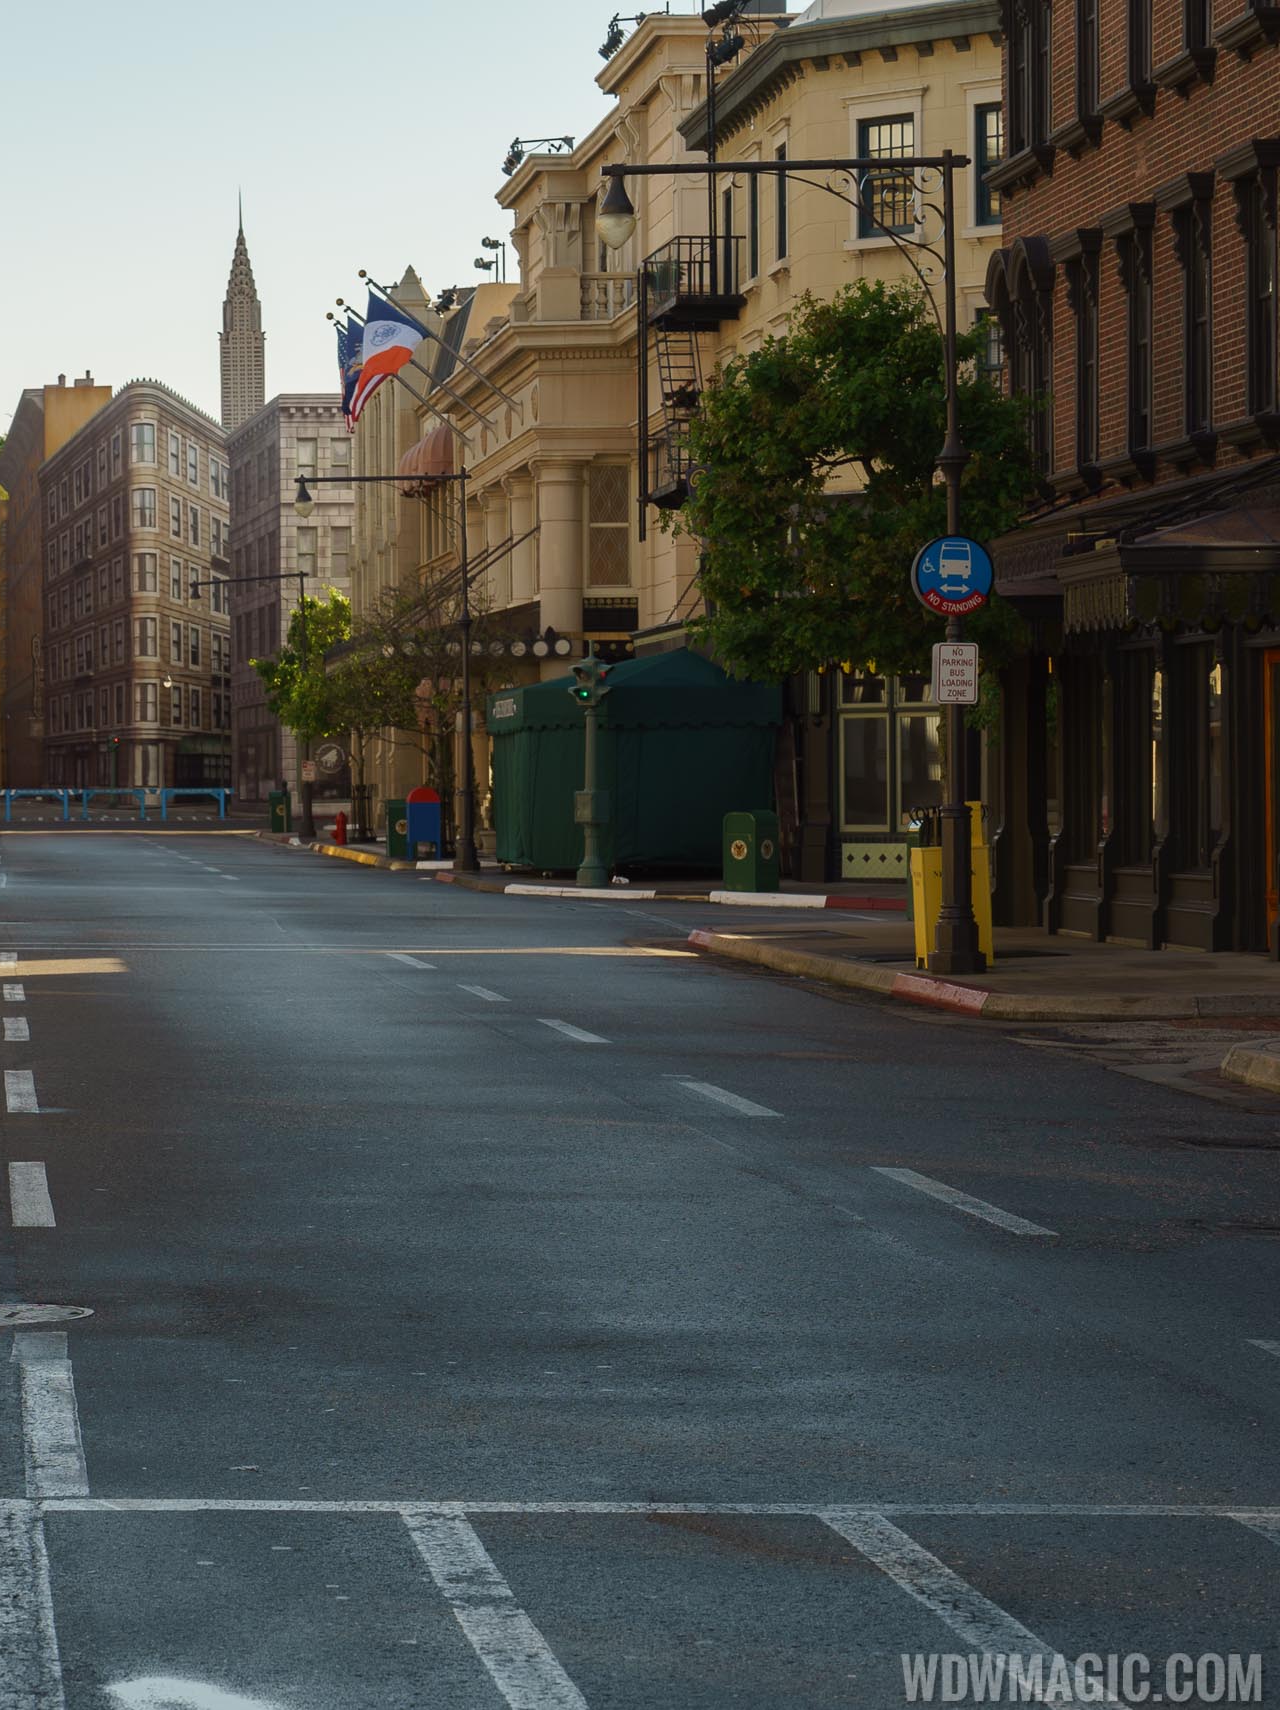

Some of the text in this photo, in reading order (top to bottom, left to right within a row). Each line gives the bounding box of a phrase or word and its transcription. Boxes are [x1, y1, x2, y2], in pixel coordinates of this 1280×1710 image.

[927, 592, 982, 612] NO STANDING
[952, 648, 964, 656] NO
[941, 658, 974, 667] PARKING
[949, 669, 965, 677] BUS
[941, 679, 973, 687] LOADING
[947, 689, 967, 697] ZONE
